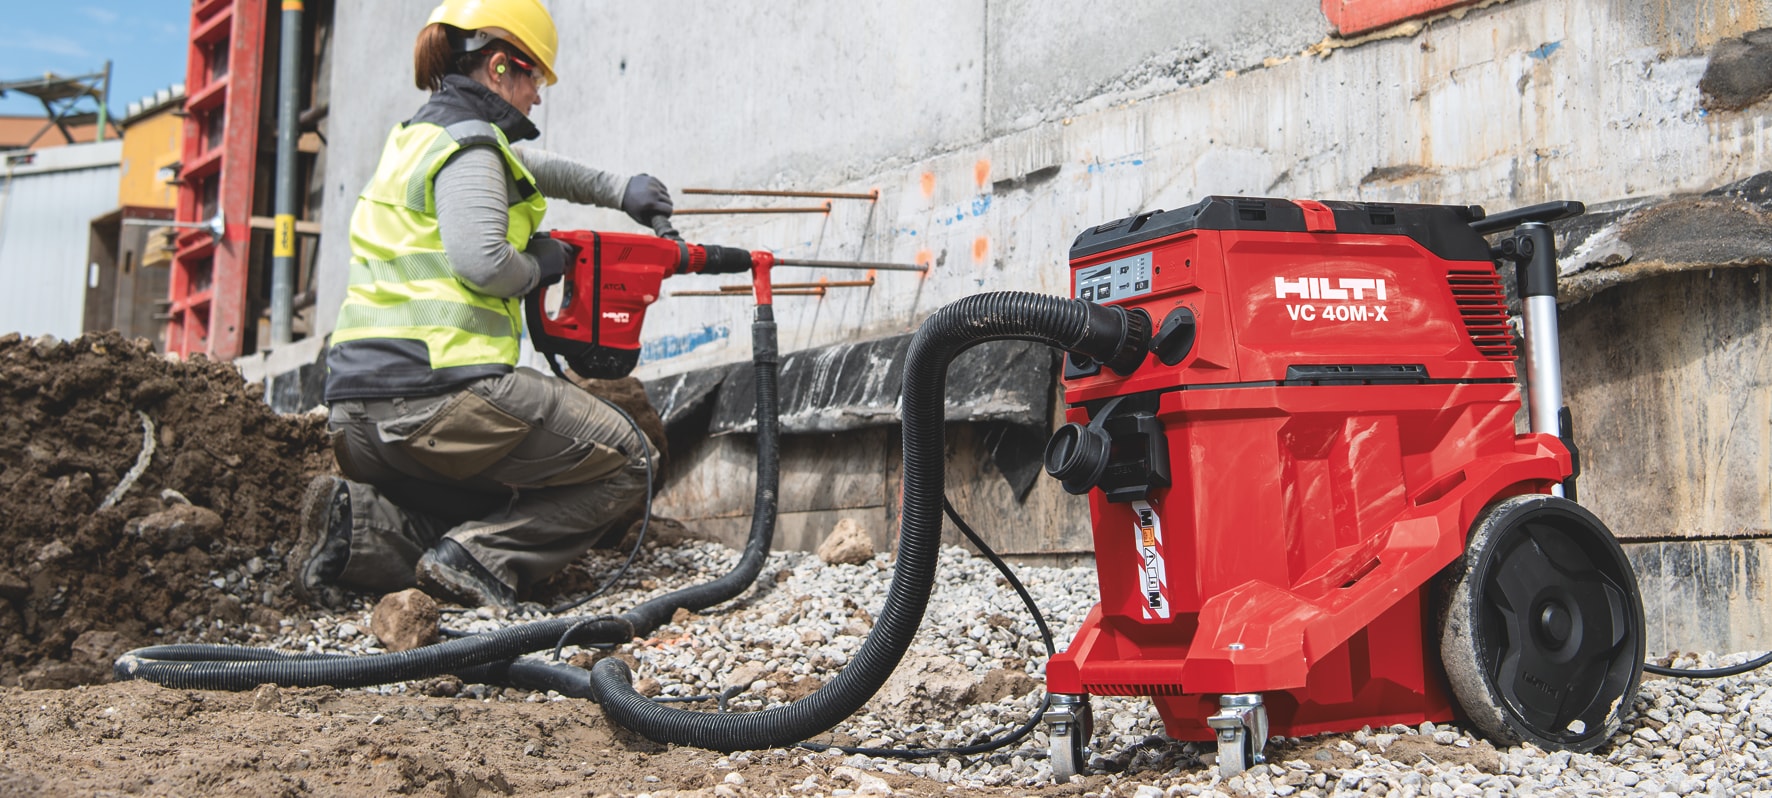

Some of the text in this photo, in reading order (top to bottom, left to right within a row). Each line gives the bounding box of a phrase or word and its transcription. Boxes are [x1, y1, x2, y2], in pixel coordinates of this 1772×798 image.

[1275, 276, 1387, 300] HILTI
[1286, 304, 1389, 321] VC 40M-X
[1141, 510, 1153, 526] M
[1149, 591, 1161, 608] M
